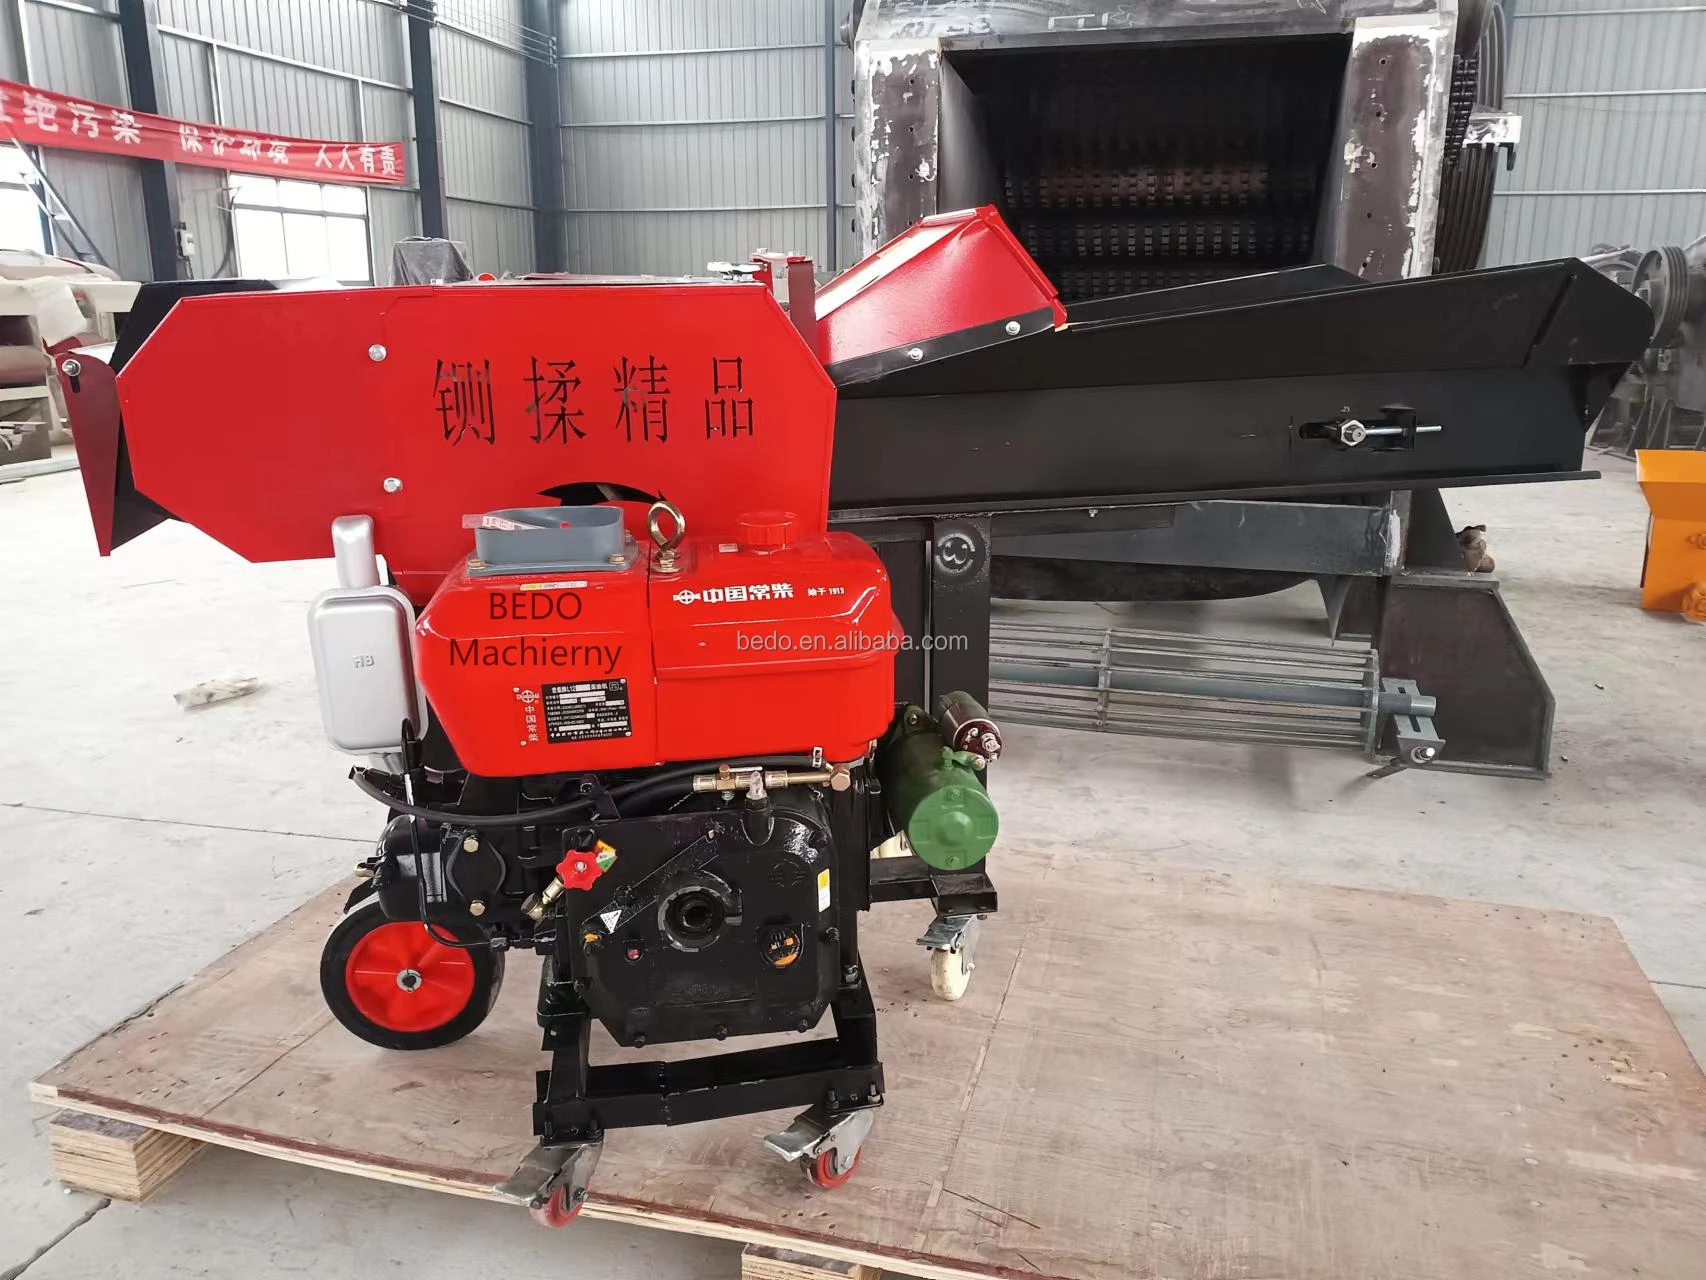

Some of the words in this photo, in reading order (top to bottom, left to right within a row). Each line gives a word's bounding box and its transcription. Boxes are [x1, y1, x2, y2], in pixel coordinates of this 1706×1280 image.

[315, 144, 396, 175] 人人有责
[432, 355, 753, 447] 铡揉精品
[703, 583, 794, 604] 中国常柴
